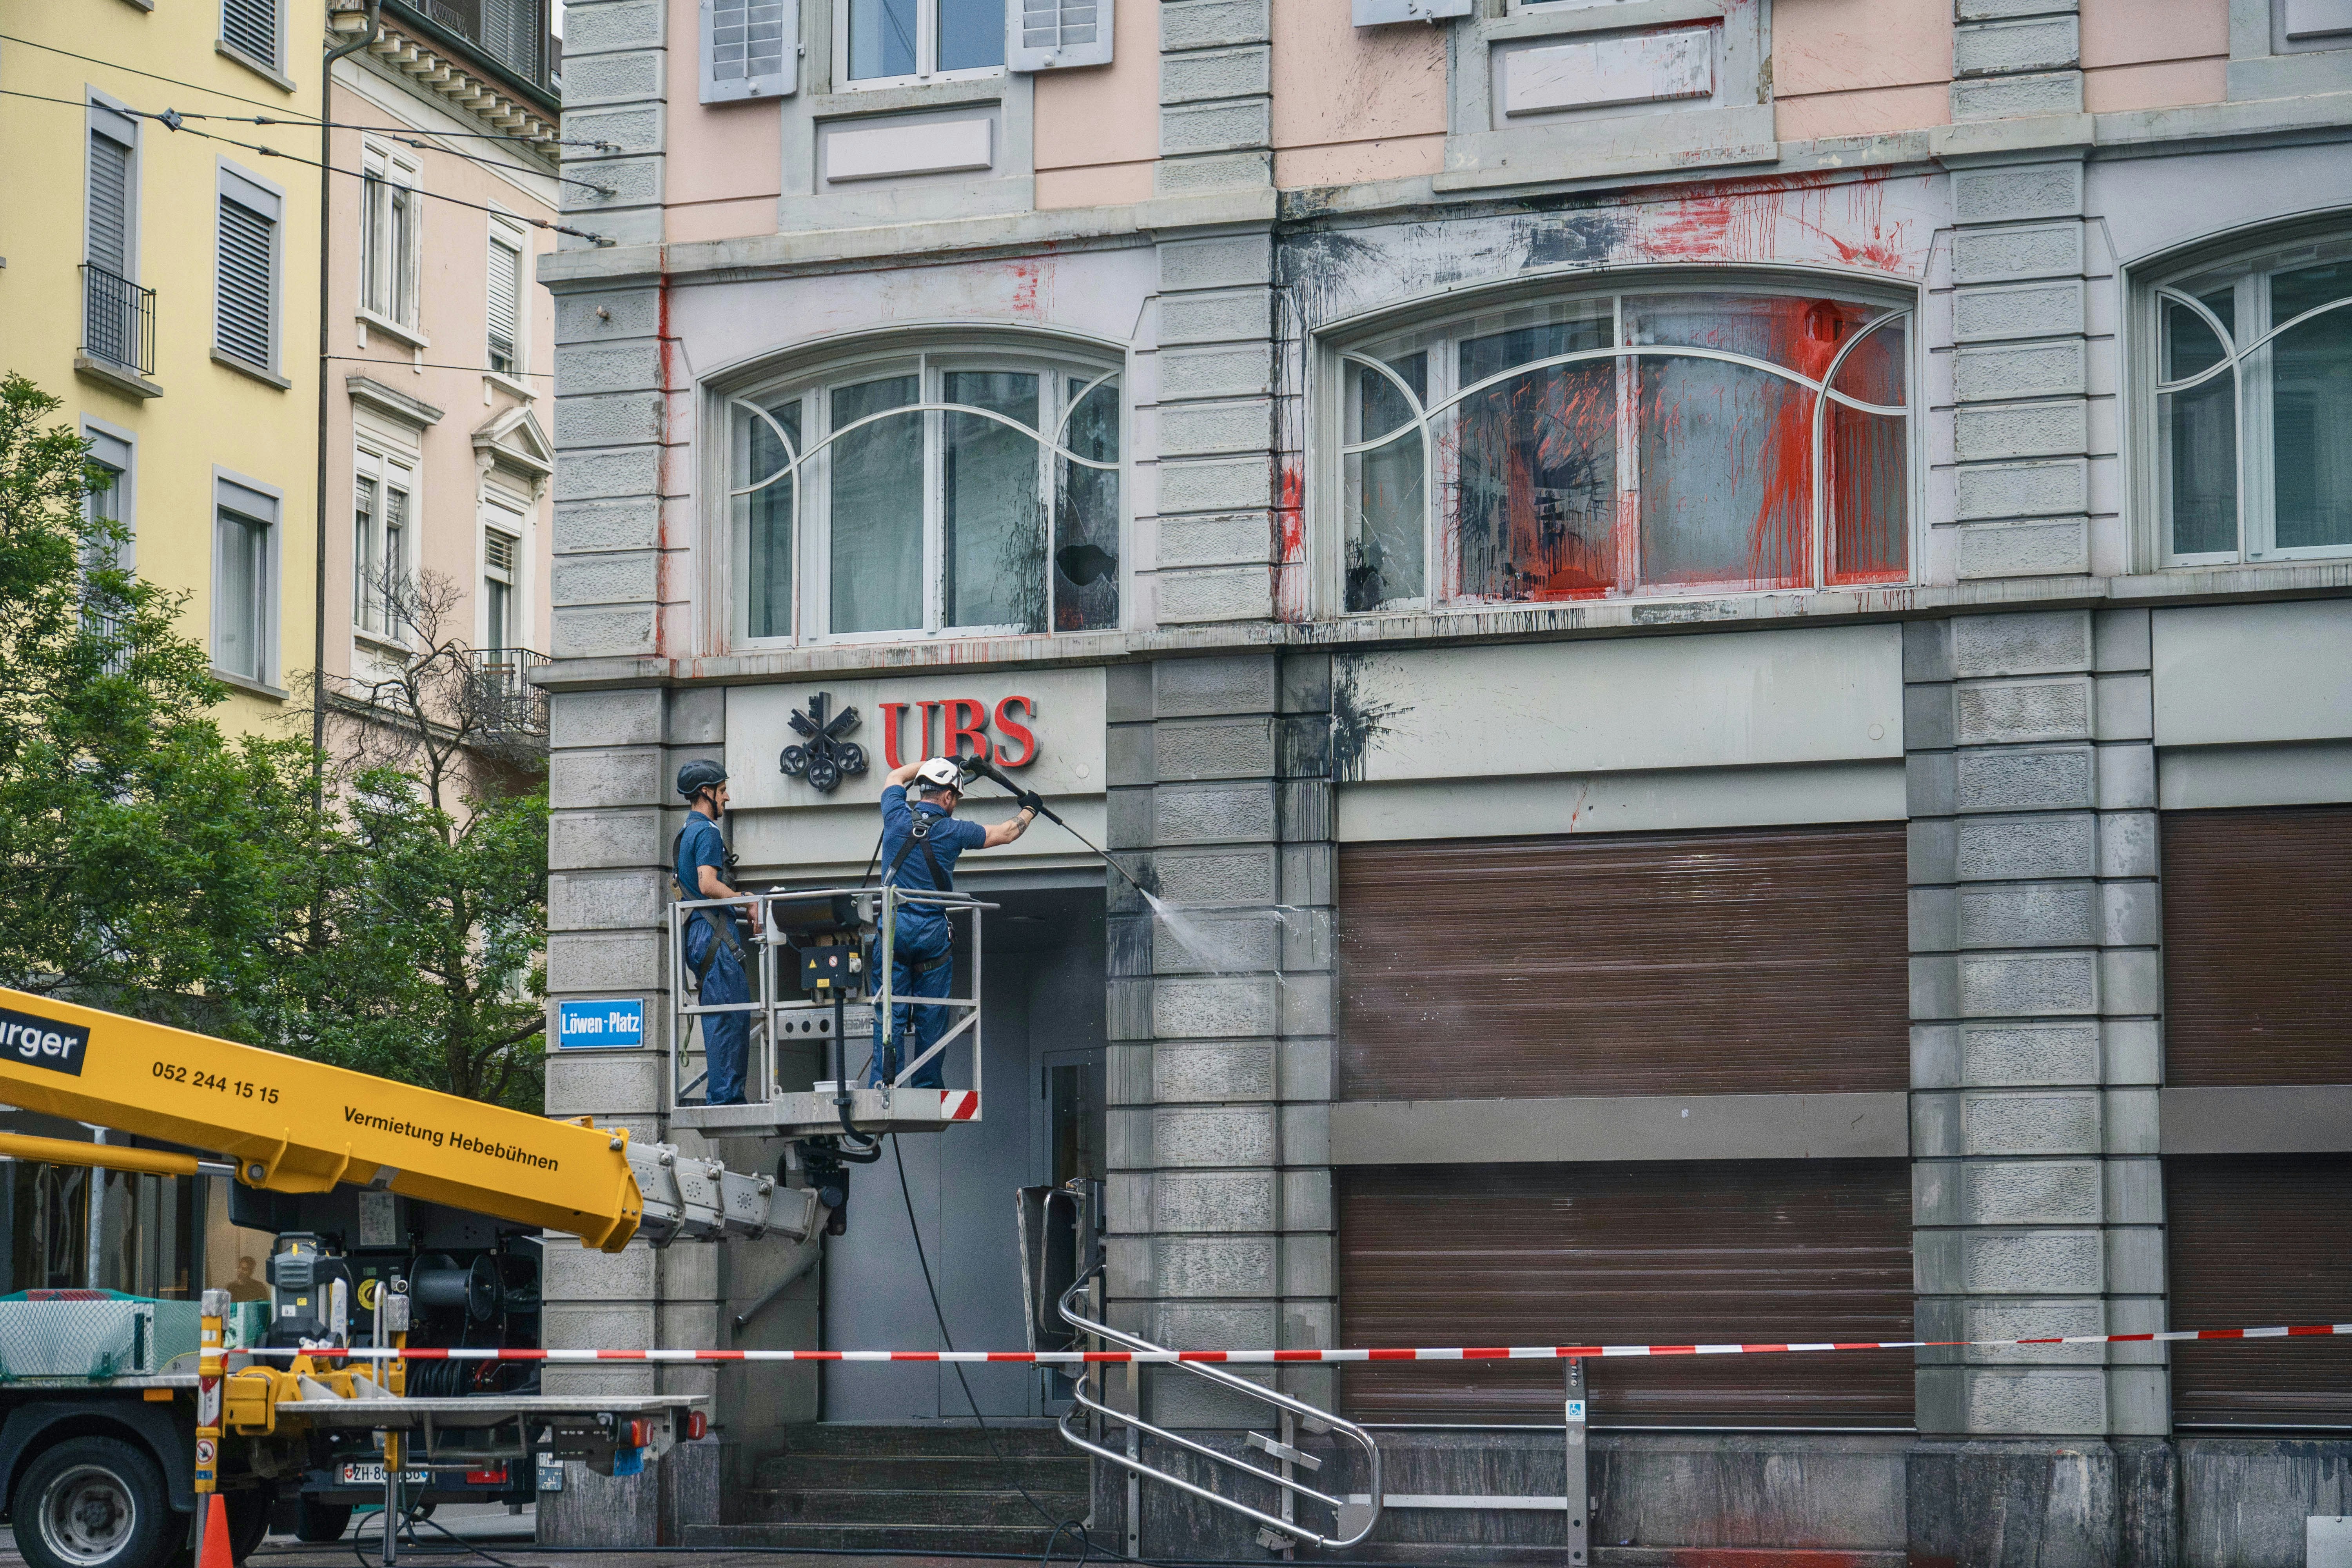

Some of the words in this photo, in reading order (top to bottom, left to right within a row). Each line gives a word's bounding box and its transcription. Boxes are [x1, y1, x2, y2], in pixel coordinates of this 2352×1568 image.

[879, 695, 1037, 769] UBS
[562, 1012, 639, 1034] Löwen-Platz
[152, 1062, 187, 1083] 052
[192, 1071, 226, 1092] 244
[234, 1081, 254, 1098] 15
[260, 1087, 279, 1104] 15
[344, 1106, 444, 1147] Vermietung
[450, 1132, 559, 1171] Hebebühnen
